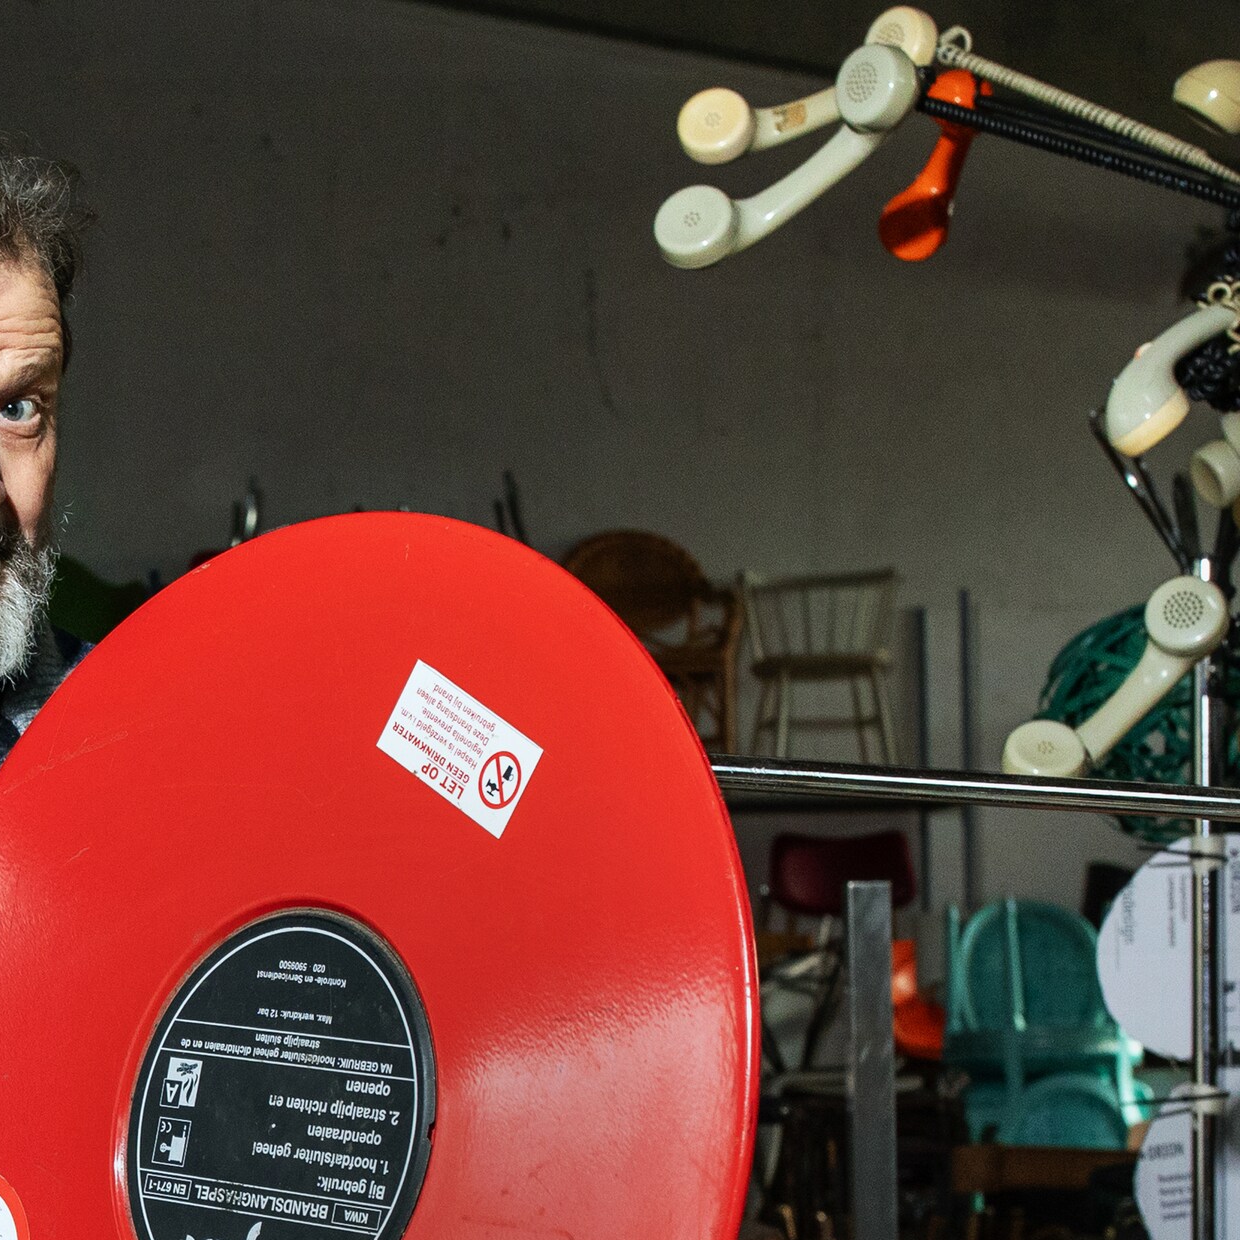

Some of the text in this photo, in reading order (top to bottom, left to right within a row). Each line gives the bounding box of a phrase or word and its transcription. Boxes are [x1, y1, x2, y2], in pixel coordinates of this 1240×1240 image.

[452, 696, 463, 710] bij
[416, 687, 489, 746] Deze brandslang alleen
[462, 705, 496, 732] gebruiken
[392, 721, 470, 784] GEEN DRINKWATER
[447, 742, 455, 753] is
[452, 730, 483, 759] legionella
[453, 748, 478, 770] Haspel
[421, 763, 465, 800] LET OP
[279, 959, 308, 972] 5909500
[312, 963, 326, 973] 020
[256, 970, 304, 984] Servicedienst
[304, 974, 314, 984] en
[257, 1007, 333, 1025] Max. werkdruk: 12 bar
[255, 1033, 321, 1050] straalpijp sluiten
[180, 1038, 393, 1074] NA GEBRUIK: hoofdafsluiter geheel dichtdraaien en de
[165, 1082, 179, 1103] A
[345, 1080, 391, 1097] openen
[268, 1094, 400, 1126] 2. straalpijp richten en
[307, 1125, 382, 1146] opendraaien
[251, 1142, 389, 1175] 1. hoofdafsluiter geheel
[148, 1179, 187, 1195] EN 671-1
[316, 1176, 386, 1200] Bij gebruik:
[194, 1184, 329, 1219] BRANDSLANGHASPEL
[344, 1209, 369, 1224] KIWA
